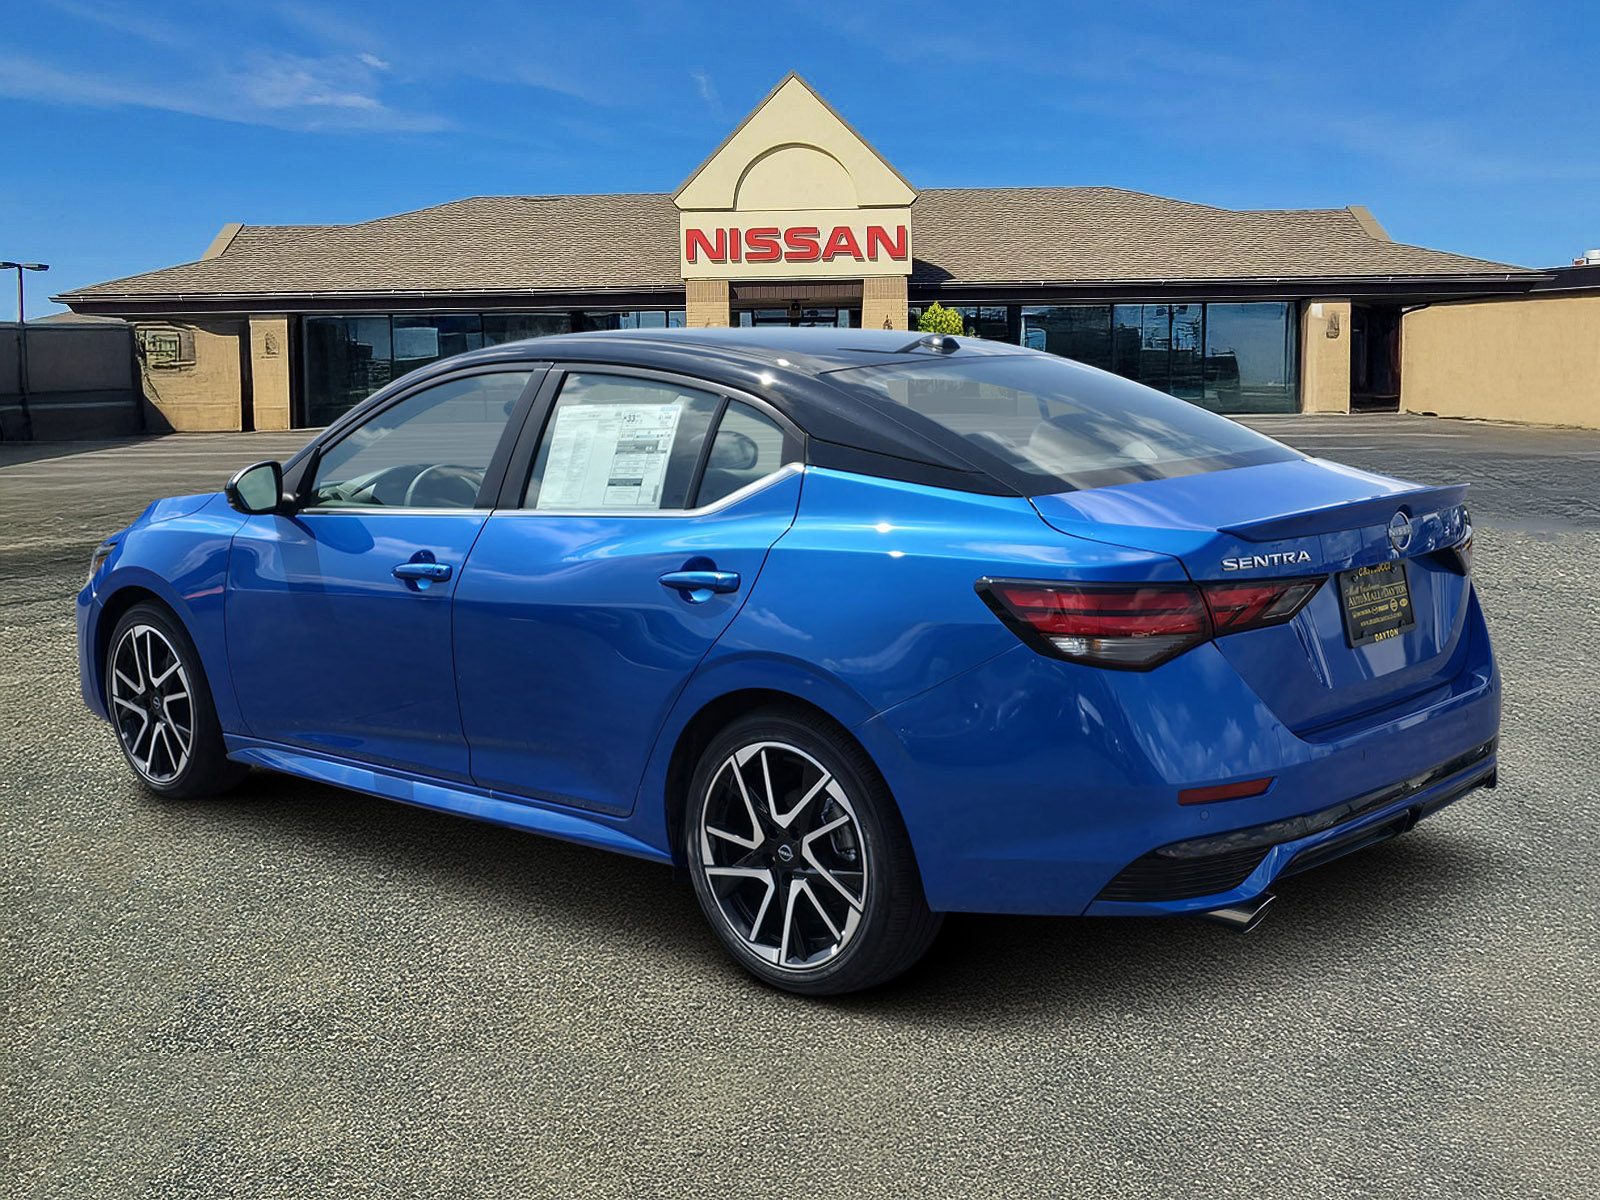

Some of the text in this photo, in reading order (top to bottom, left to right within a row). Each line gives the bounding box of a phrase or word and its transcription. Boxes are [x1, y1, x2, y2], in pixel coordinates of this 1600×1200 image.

[685, 225, 907, 263] NISSAN
[1222, 550, 1312, 571] SENTRA
[1374, 628, 1399, 642] DAYTON
